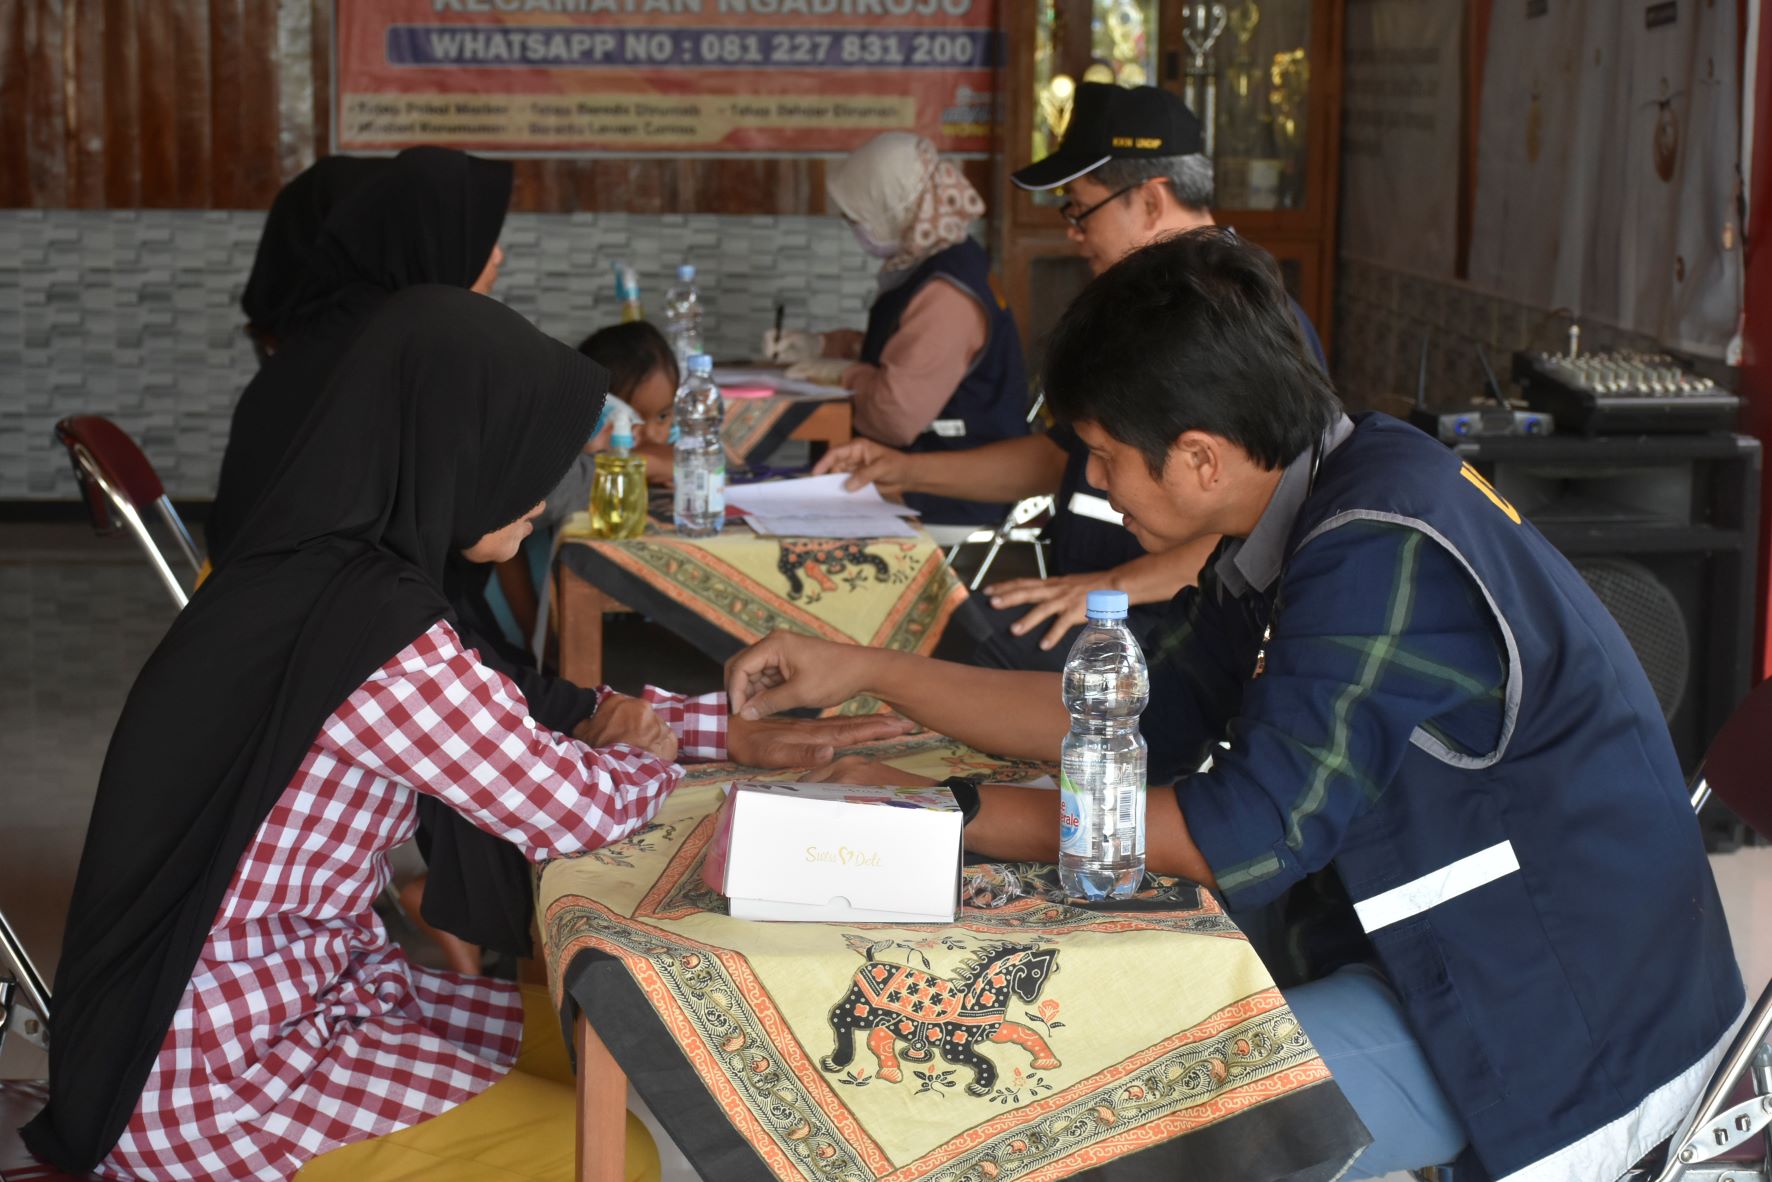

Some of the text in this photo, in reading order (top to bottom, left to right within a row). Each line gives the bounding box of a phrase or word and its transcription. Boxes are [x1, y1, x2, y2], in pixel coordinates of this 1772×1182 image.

[431, 32, 616, 61] WHATSAPP
[624, 33, 674, 61] NO
[701, 34, 763, 62] 081
[771, 34, 832, 62] 227
[841, 34, 904, 63] 831
[912, 35, 974, 64] 200
